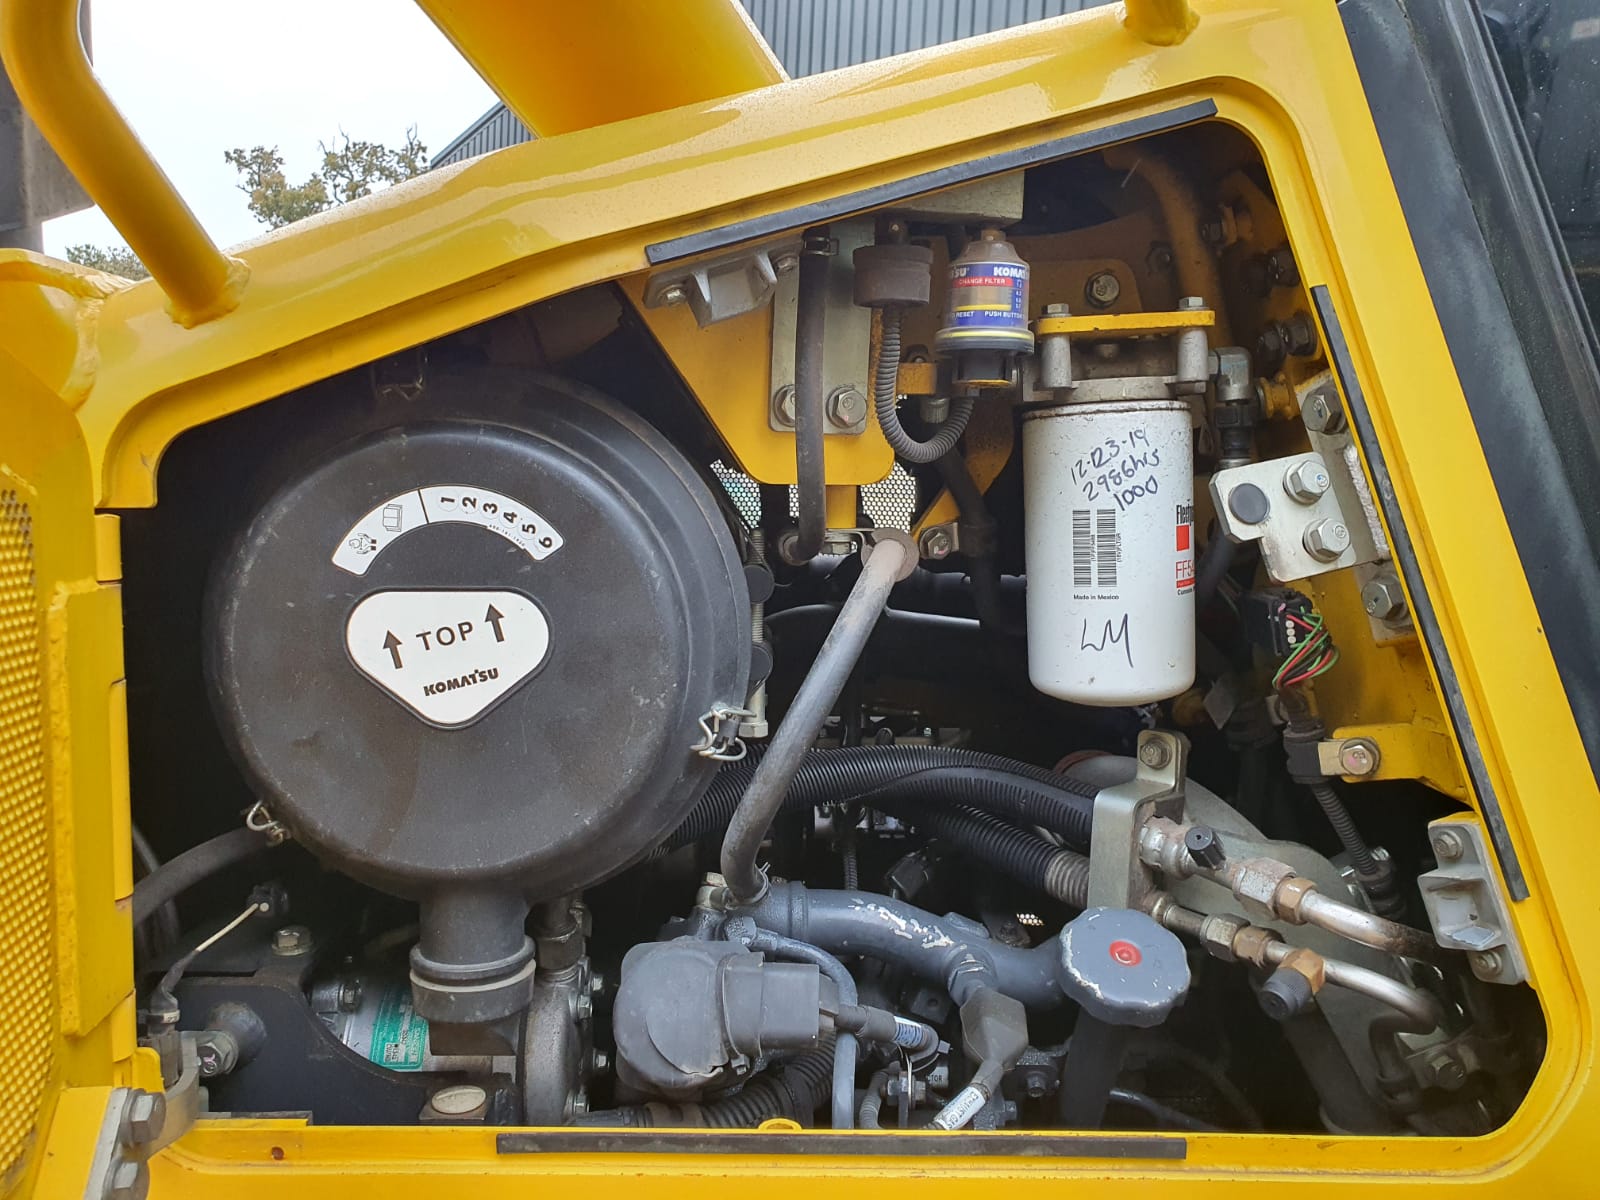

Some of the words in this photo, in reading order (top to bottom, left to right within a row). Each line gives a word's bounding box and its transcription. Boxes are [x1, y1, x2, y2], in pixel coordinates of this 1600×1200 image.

[984, 310, 1002, 318] PUSH
[1113, 474, 1158, 512] 1000
[462, 496, 477, 509] 2
[482, 502, 498, 514] 3
[502, 511, 518, 524] 4
[521, 523, 536, 536] 5
[538, 536, 553, 549] 6
[415, 621, 474, 651] TOP
[423, 667, 499, 697] KOMATSU
